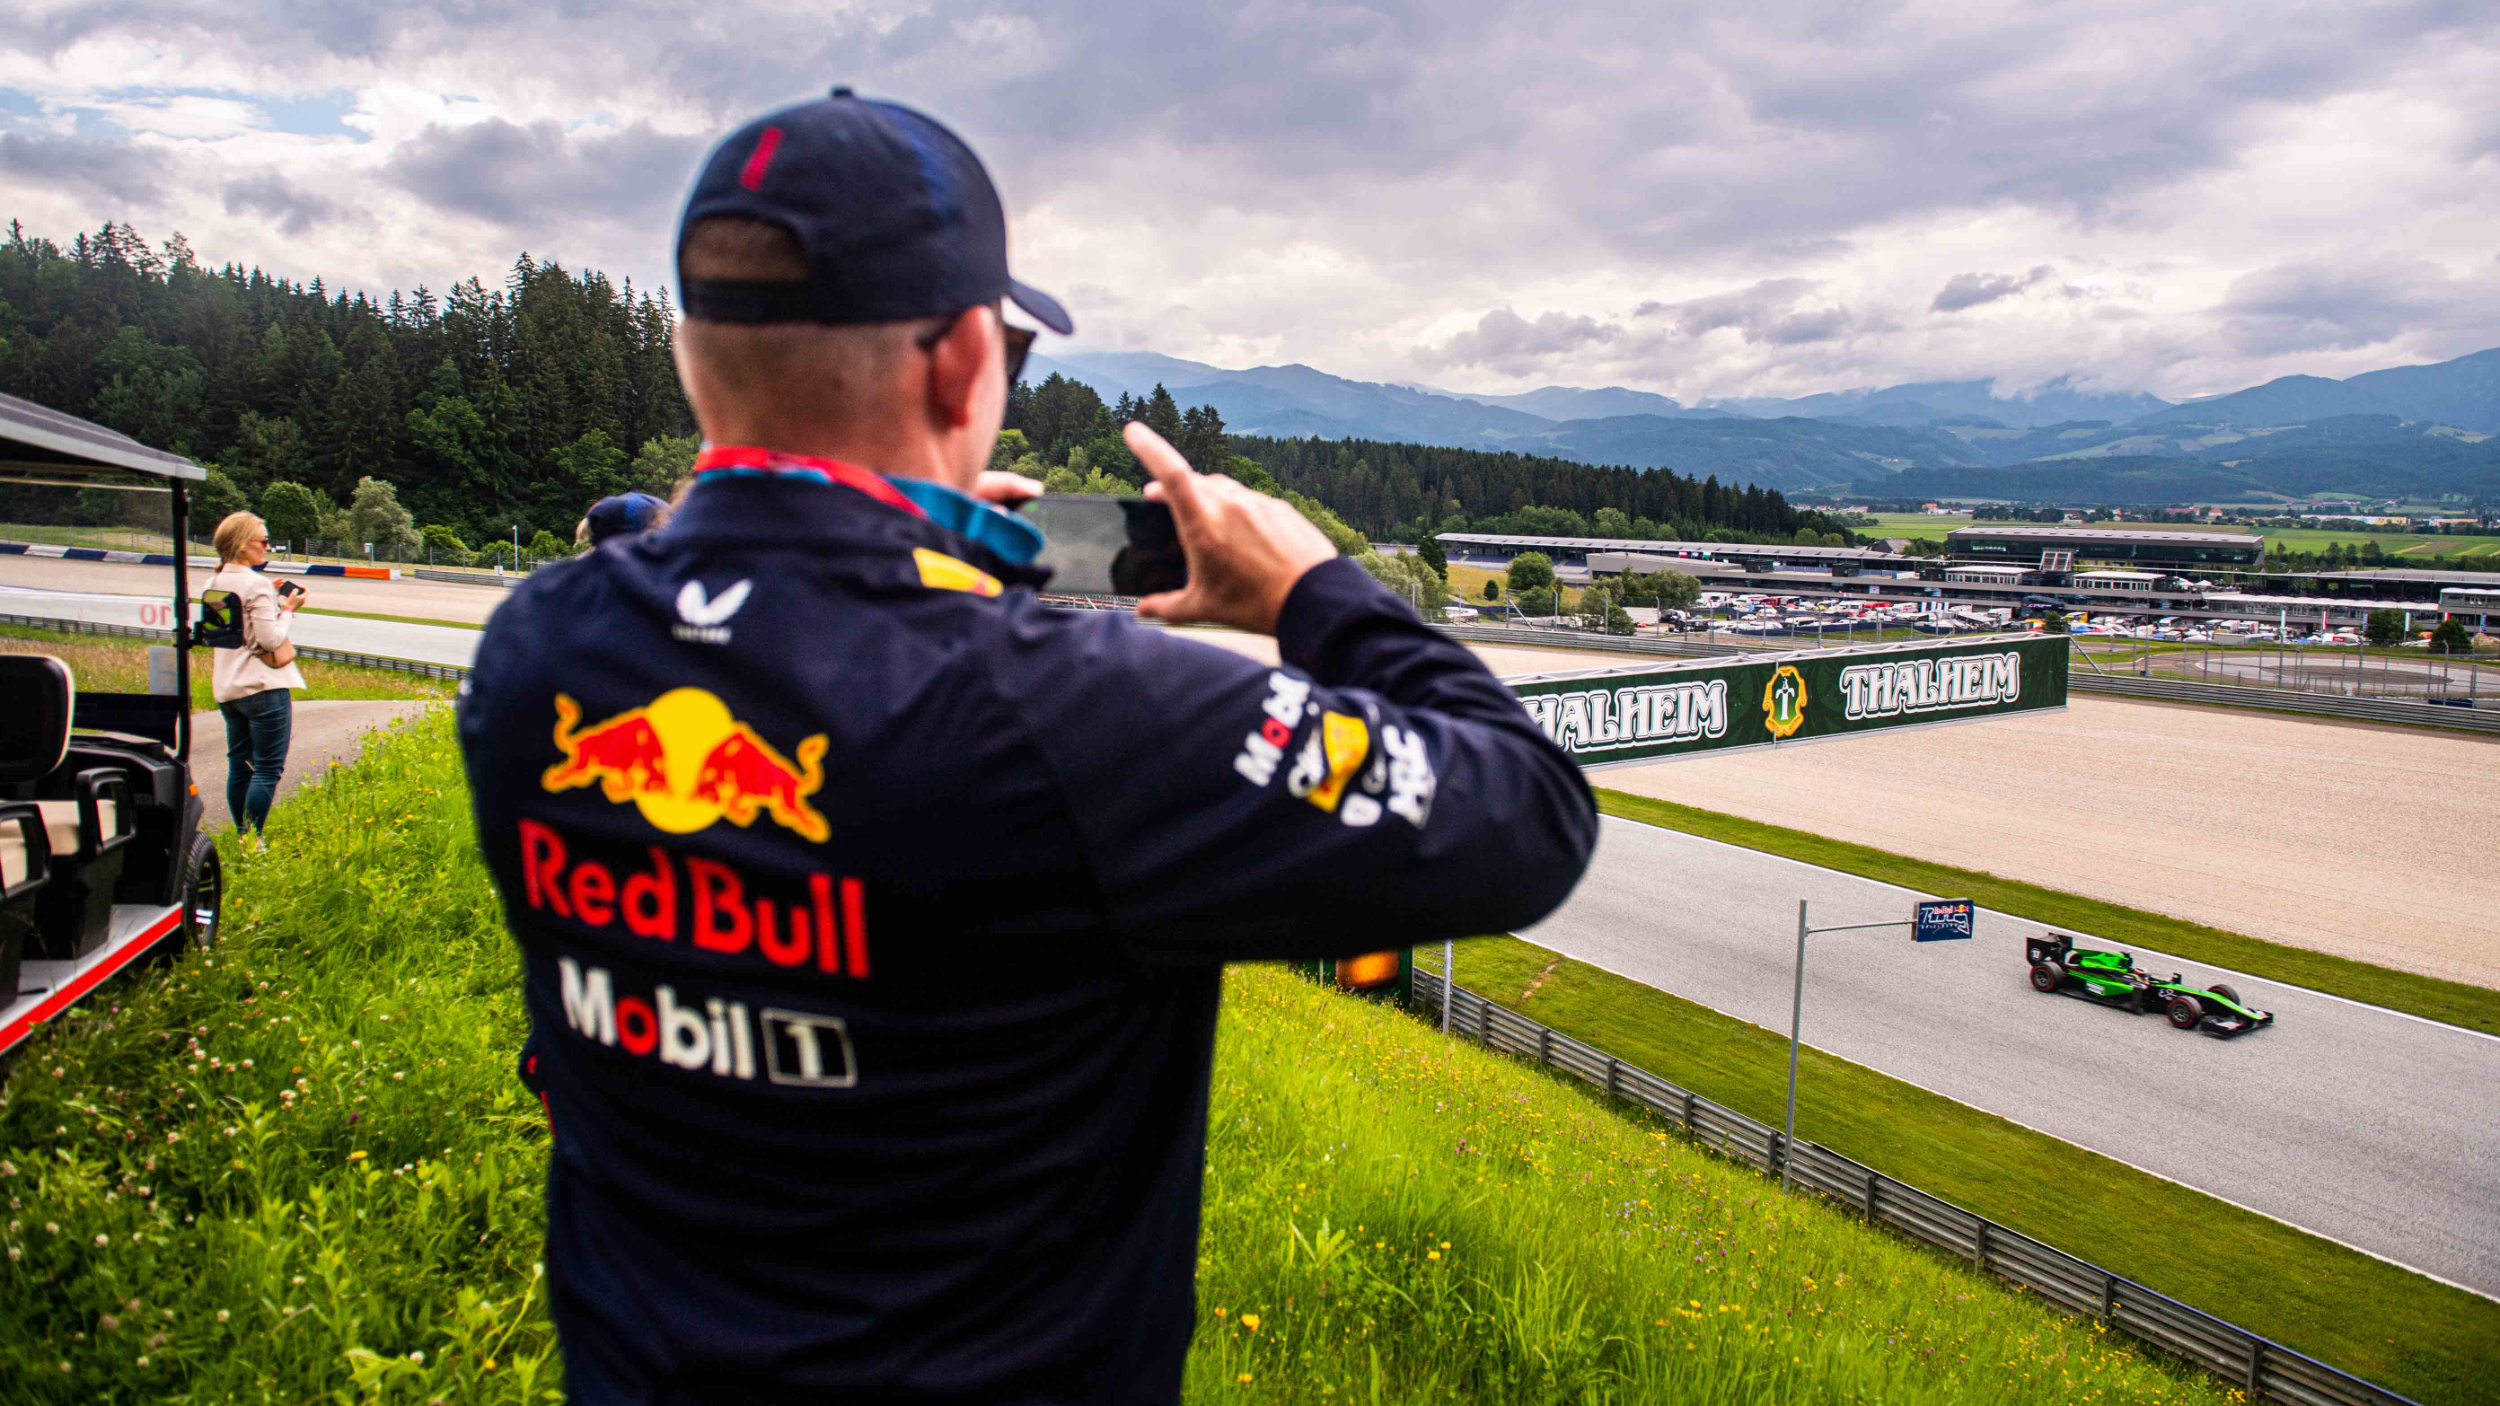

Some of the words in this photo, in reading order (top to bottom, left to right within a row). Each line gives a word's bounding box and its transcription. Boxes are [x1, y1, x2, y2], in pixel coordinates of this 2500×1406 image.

[1519, 681, 1726, 751] HALHEIM
[1841, 653, 2020, 719] THALHEIM
[519, 819, 677, 942] Red
[687, 856, 870, 979] Bull
[558, 956, 757, 1080] Mobil
[786, 1023, 822, 1080] 1
